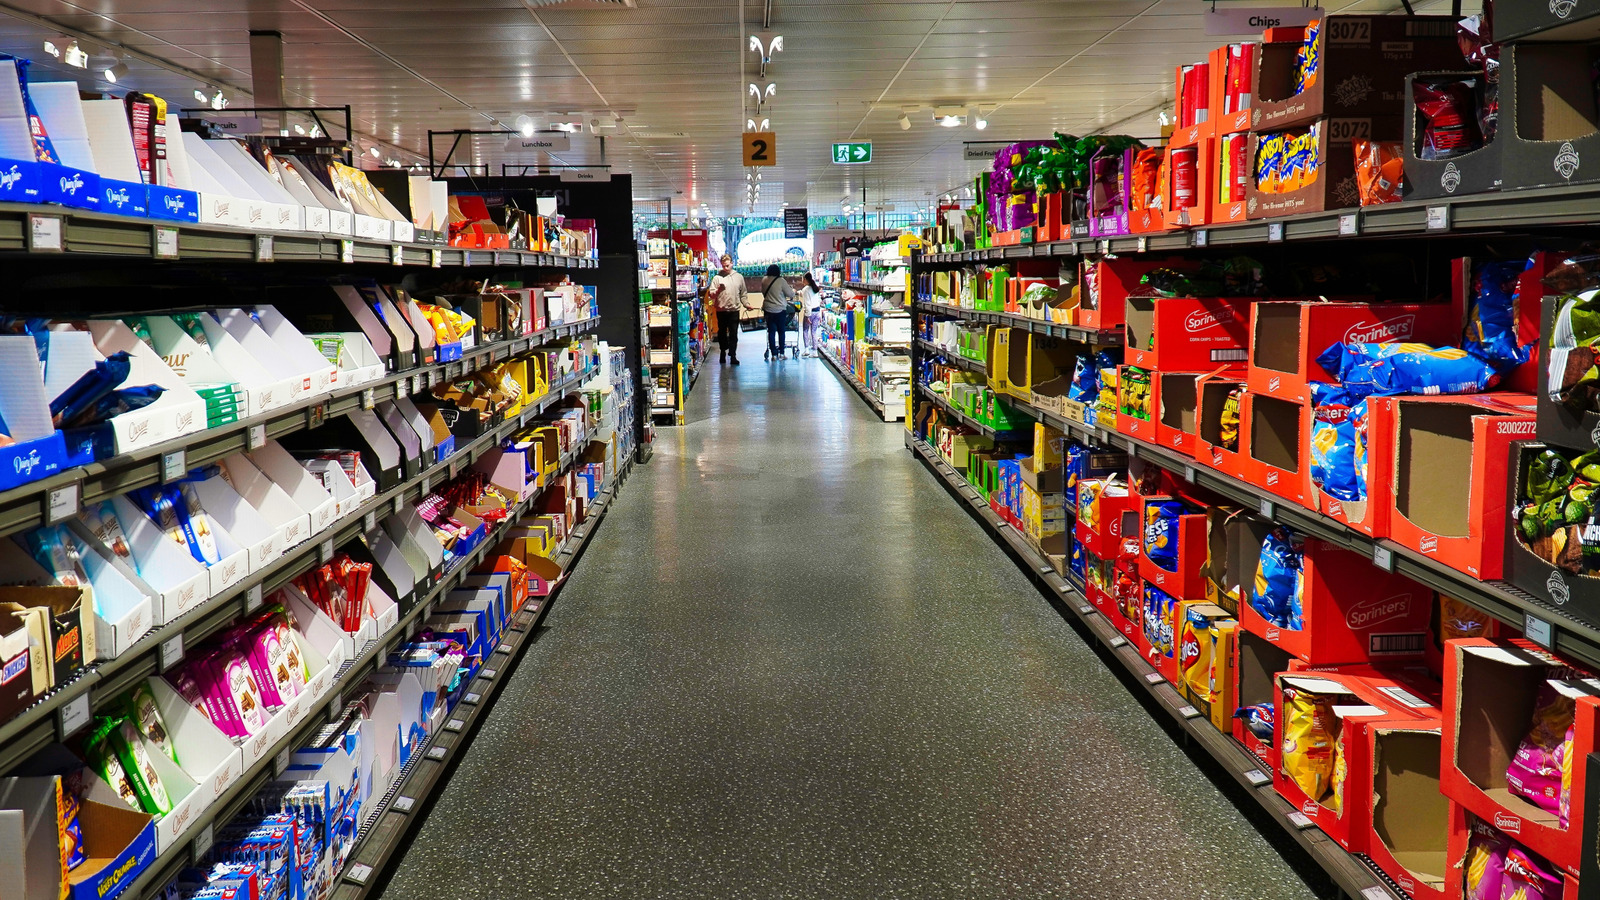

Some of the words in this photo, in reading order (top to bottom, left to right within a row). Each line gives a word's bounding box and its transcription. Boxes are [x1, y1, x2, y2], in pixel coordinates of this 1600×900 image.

[1248, 16, 1280, 29] Chips
[1331, 22, 1368, 40] 3072
[751, 140, 767, 160] 2
[1188, 310, 1231, 329] Sprinters
[1349, 320, 1409, 345] Sprinters
[1386, 402, 1391, 412] 3
[1497, 421, 1536, 434] 32002272
[1350, 602, 1406, 625] Sprinters
[55, 626, 78, 657] Mars
[3, 654, 27, 683] SNICKERS
[1496, 817, 1519, 829] Sprinters
